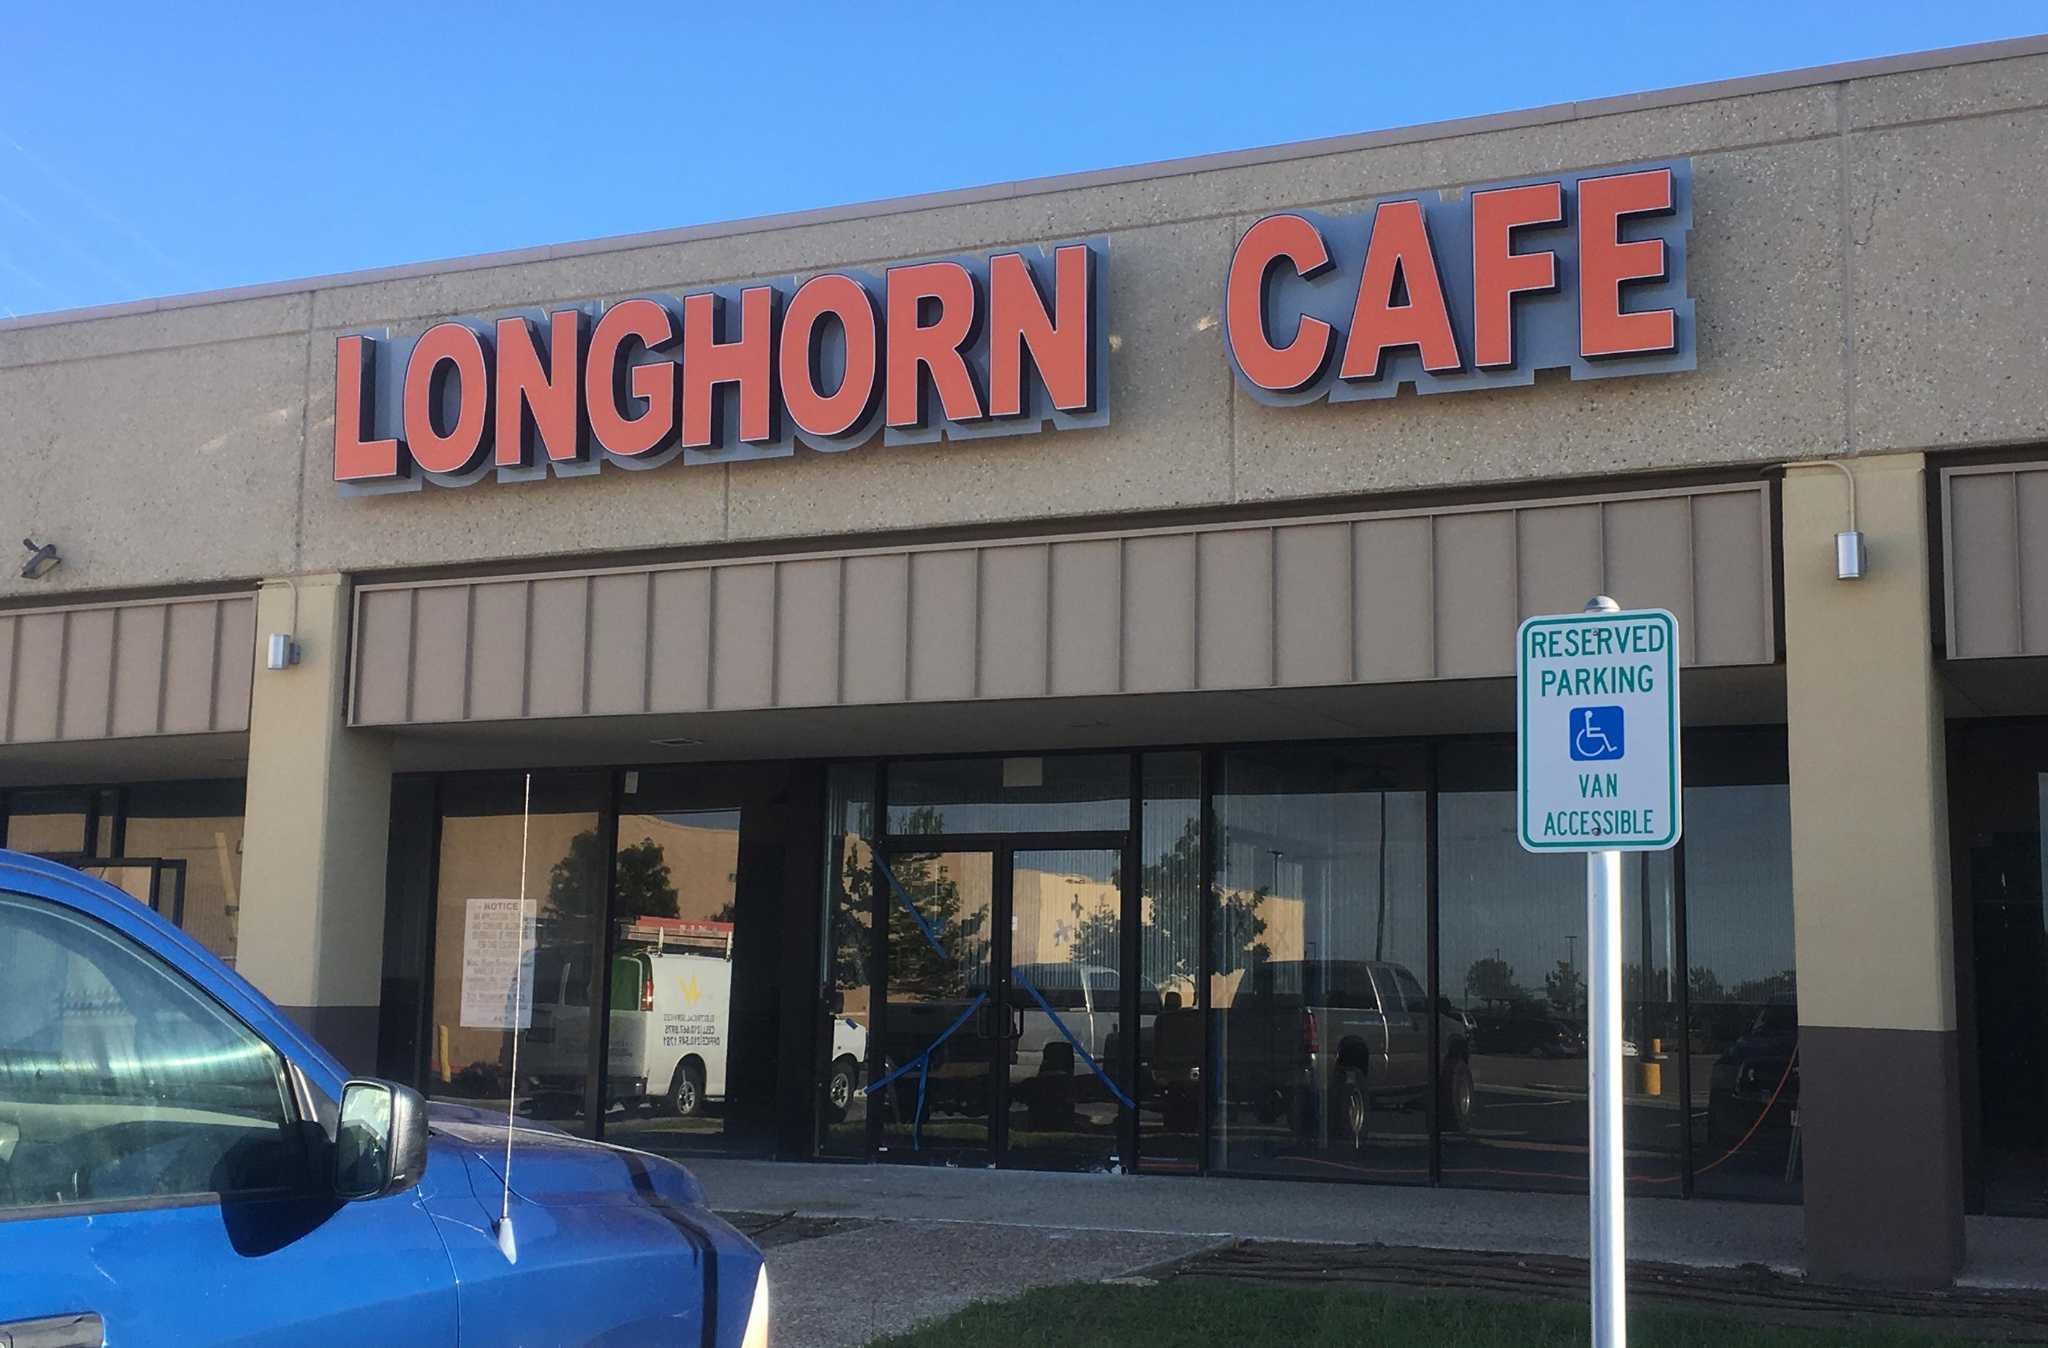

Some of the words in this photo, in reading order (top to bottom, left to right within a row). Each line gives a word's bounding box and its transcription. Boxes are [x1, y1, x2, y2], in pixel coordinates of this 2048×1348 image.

[333, 243, 1098, 484] LONGHORN
[1226, 167, 1679, 393] CAFE
[1531, 625, 1665, 659] RESERVED
[1541, 665, 1654, 697] PARKING
[1578, 773, 1618, 798] VAN
[1543, 809, 1654, 837] ACCESSIBLE
[483, 902, 519, 911] NOTICE
